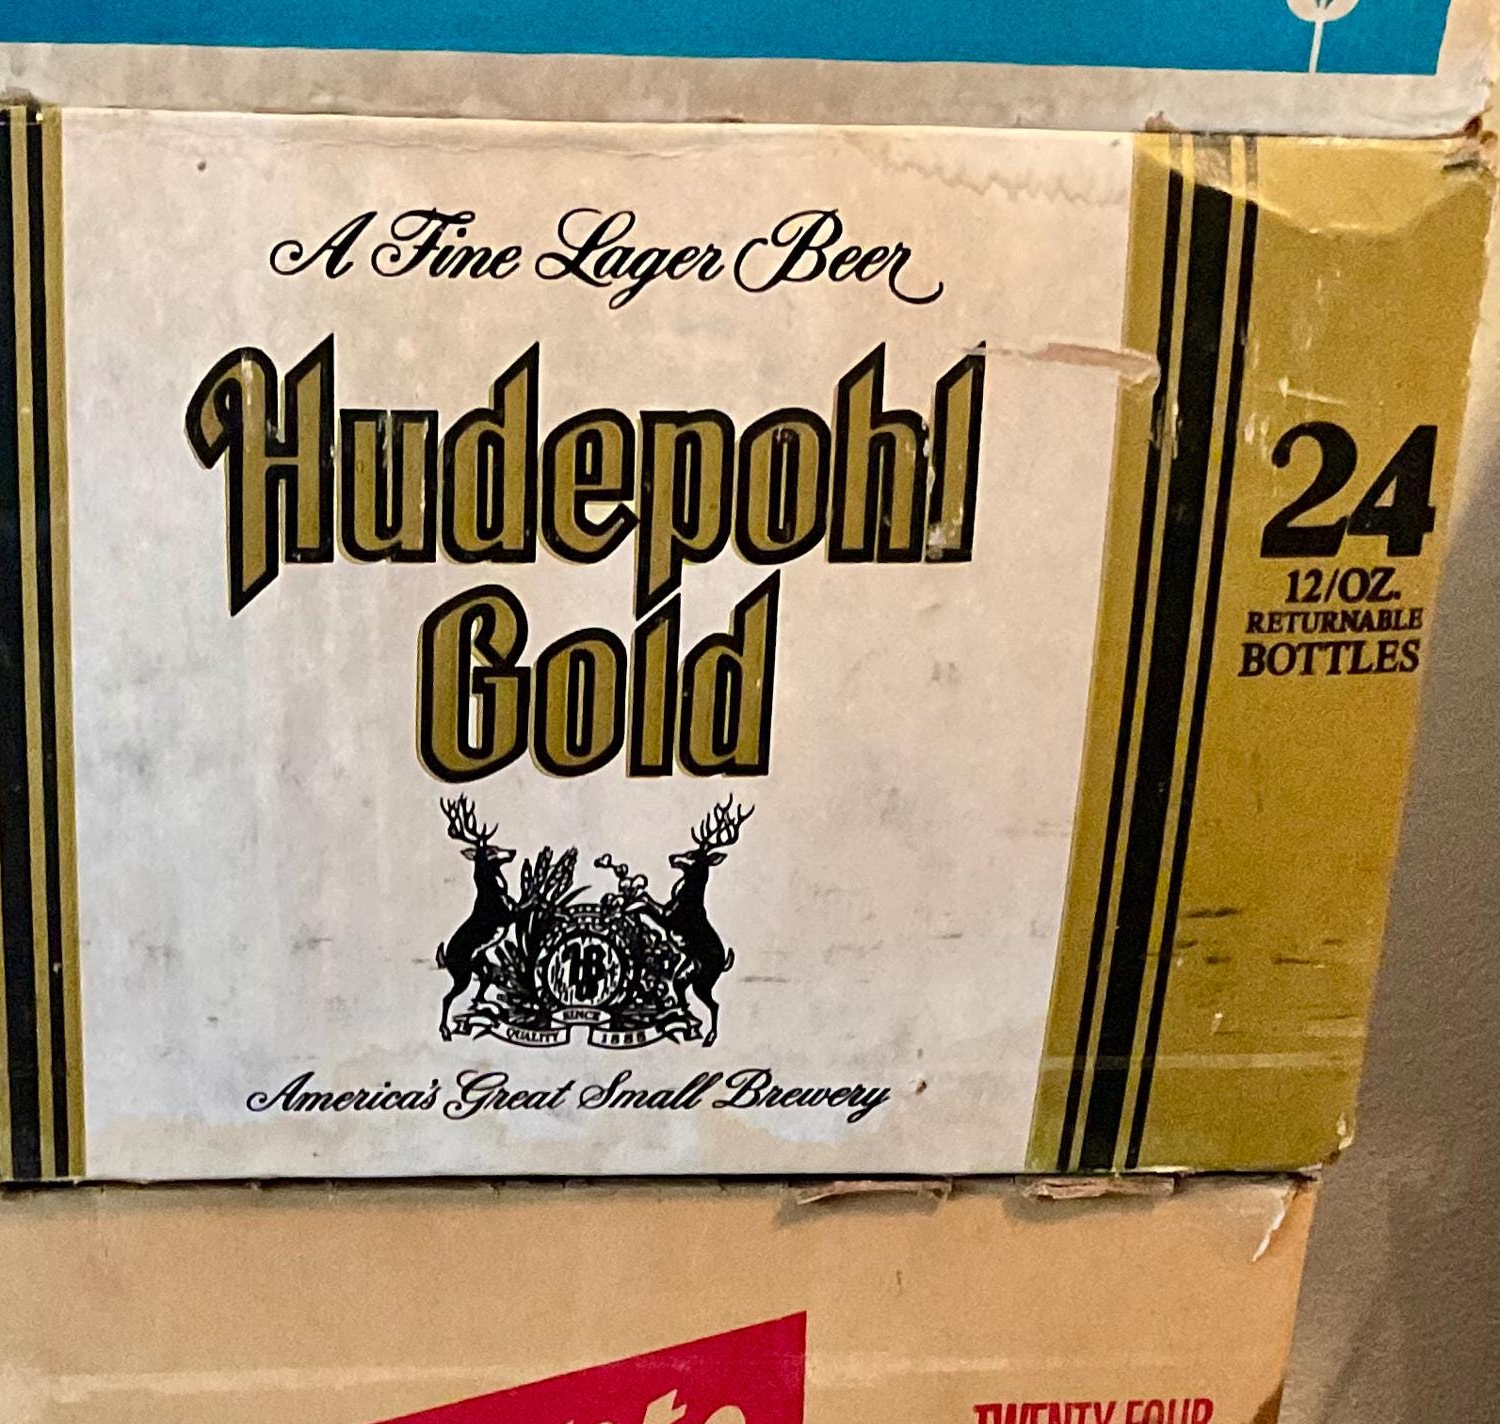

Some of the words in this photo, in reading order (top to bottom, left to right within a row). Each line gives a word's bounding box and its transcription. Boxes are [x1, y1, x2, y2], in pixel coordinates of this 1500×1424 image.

[269, 210, 378, 280] A
[371, 207, 522, 280] Fine
[534, 207, 724, 310] Lager
[733, 209, 945, 304] Beer
[184, 332, 988, 622] Hudepohl
[1260, 421, 1438, 558] 24
[1244, 607, 1424, 635] RETURNABLE
[1285, 566, 1401, 604] 12/OZ.
[417, 568, 782, 784] Gold
[1237, 638, 1422, 677] BOTTLES
[245, 1070, 442, 1113] America's
[443, 1069, 575, 1120] Great
[578, 1068, 720, 1110] Small
[712, 1068, 894, 1123] Brewery
